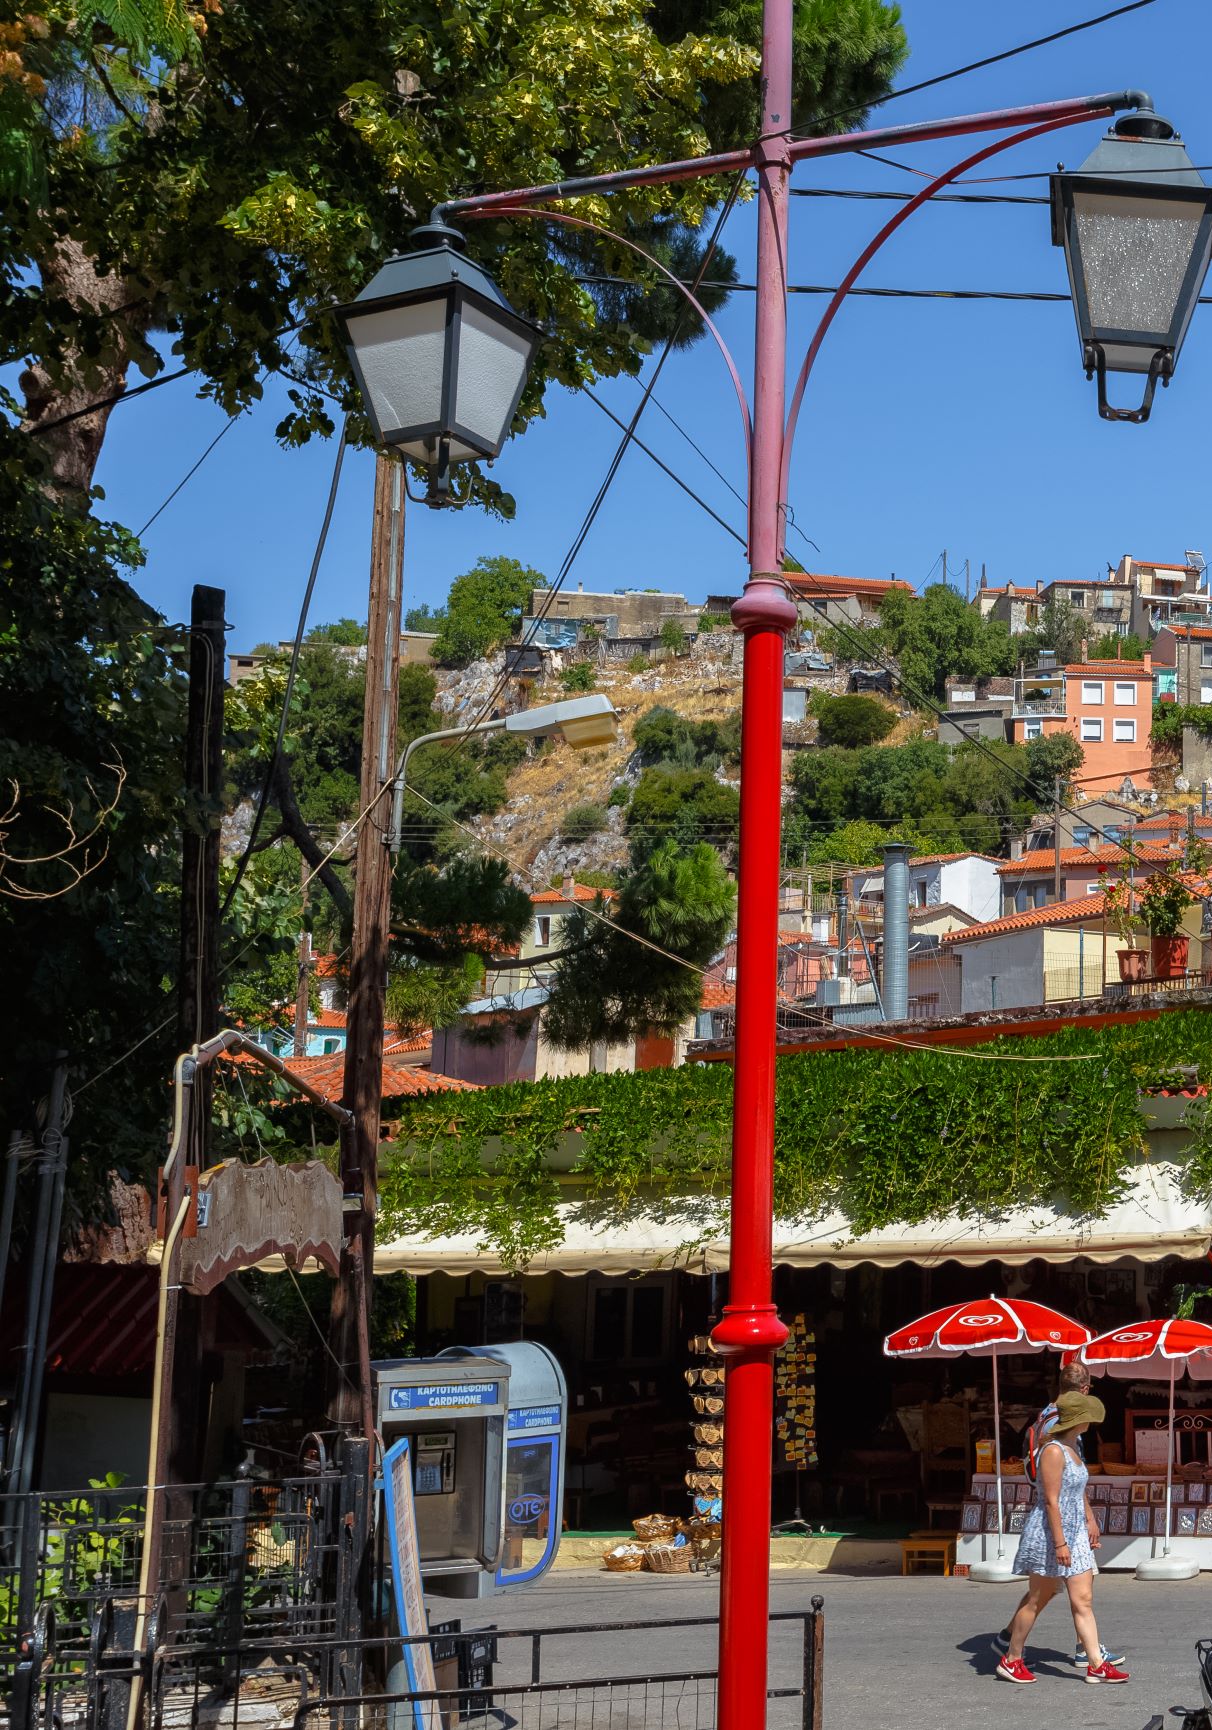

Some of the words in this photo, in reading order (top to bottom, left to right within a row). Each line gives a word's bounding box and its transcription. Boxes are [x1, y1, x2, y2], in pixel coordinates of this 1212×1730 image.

[417, 1383, 494, 1396] ΚΑΡΤΟΤΗΛΕΦΩΝΟ
[428, 1395, 482, 1406] CARDPHONE
[525, 1417, 553, 1427] CARDPHONE
